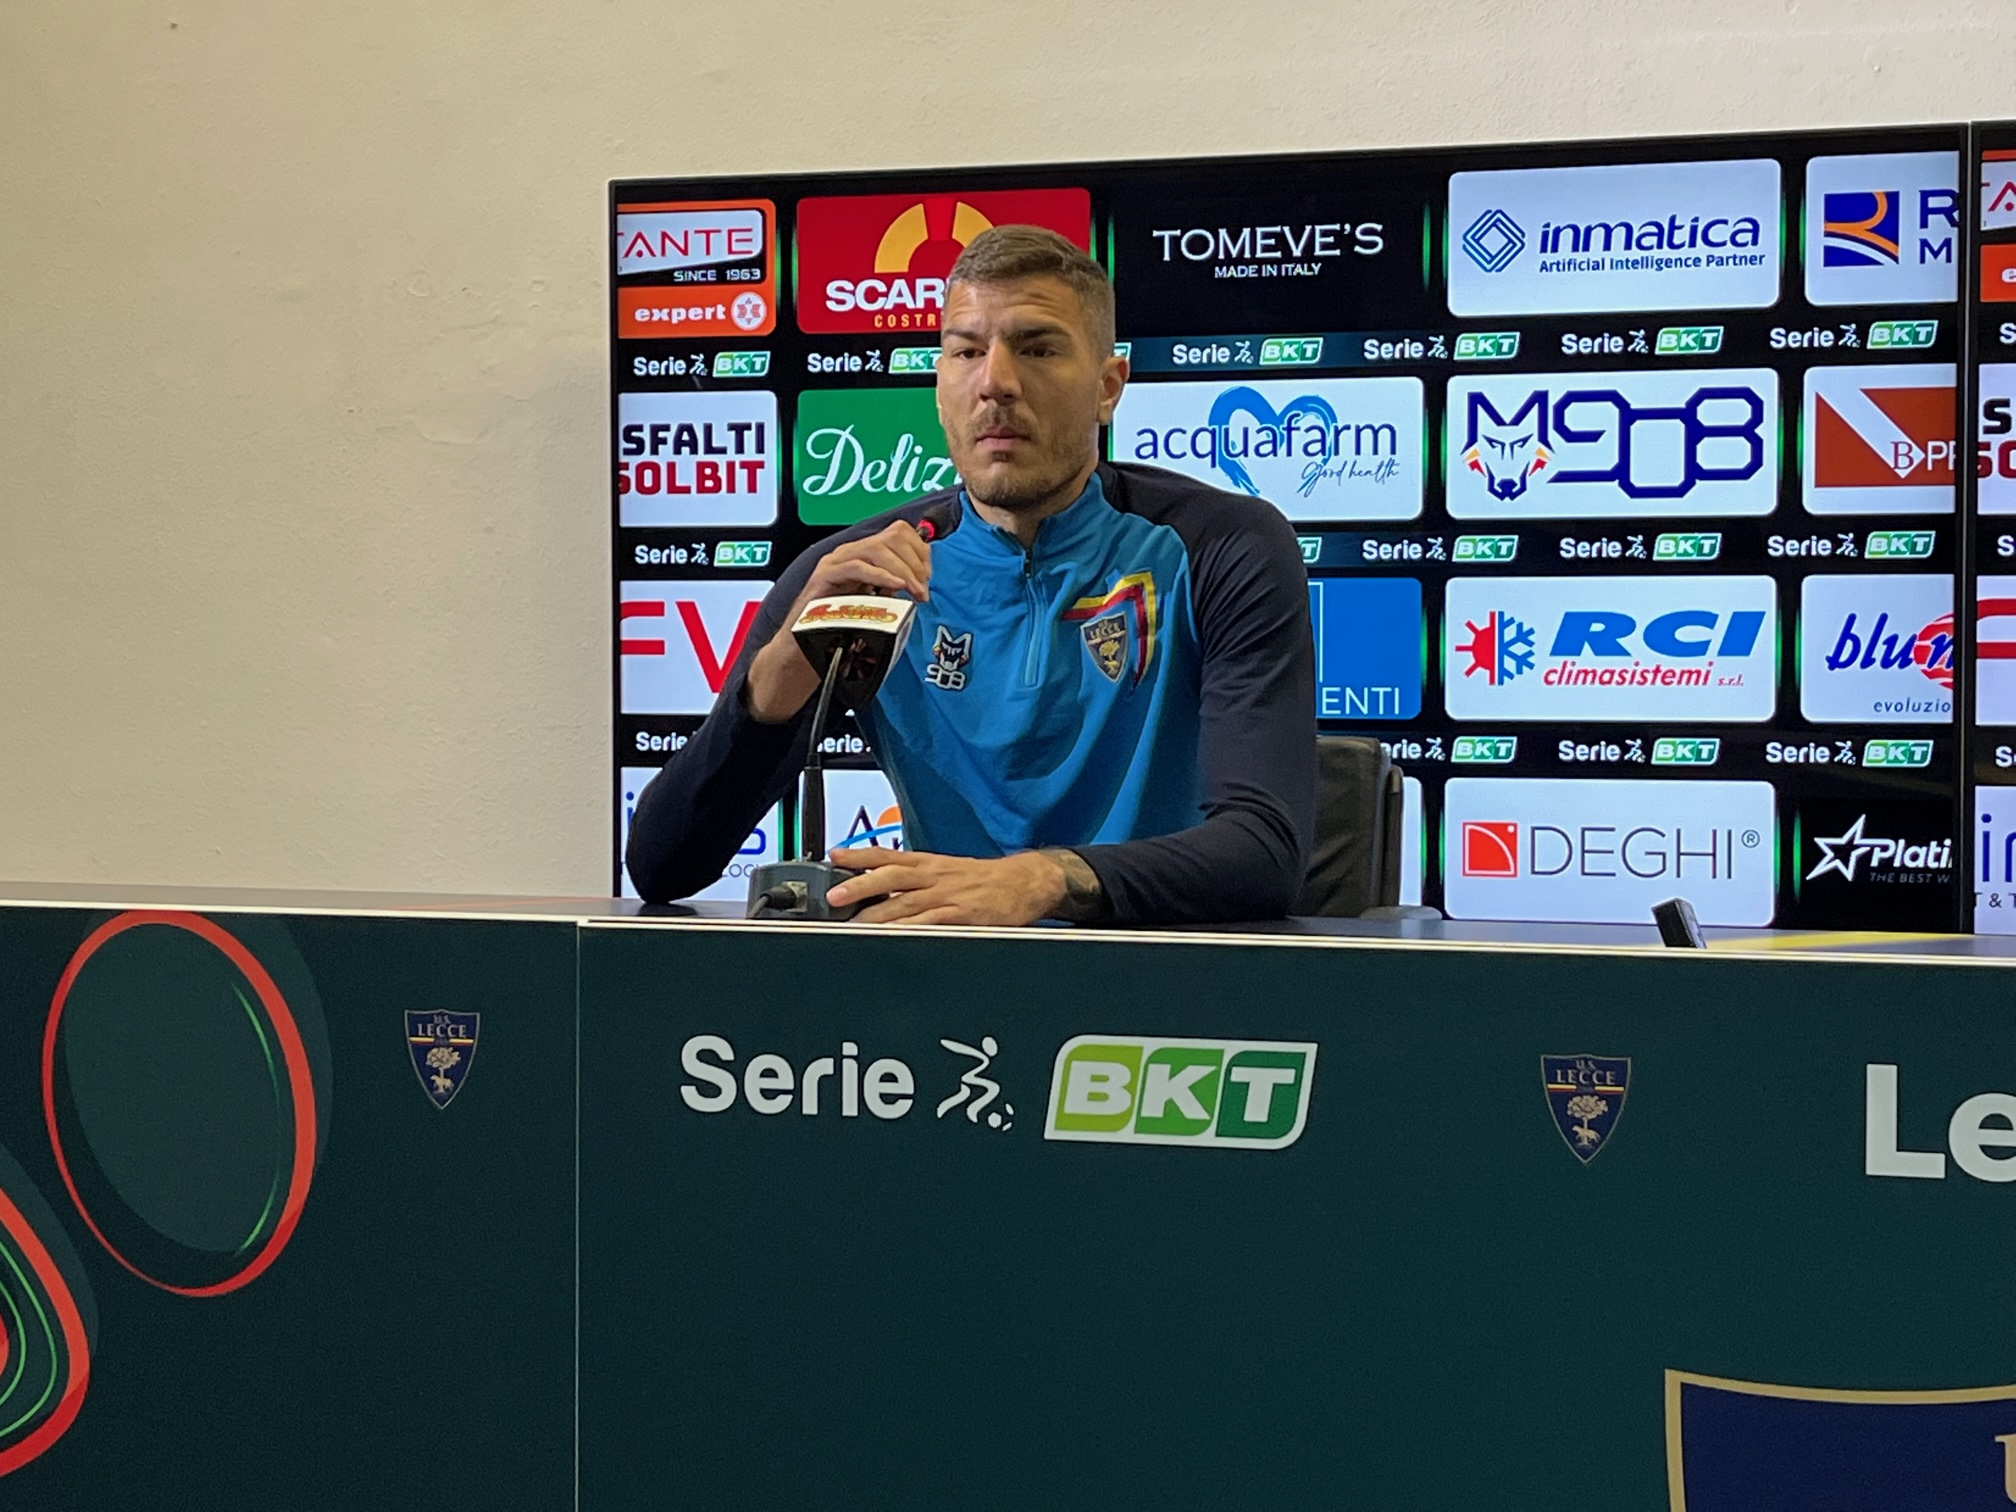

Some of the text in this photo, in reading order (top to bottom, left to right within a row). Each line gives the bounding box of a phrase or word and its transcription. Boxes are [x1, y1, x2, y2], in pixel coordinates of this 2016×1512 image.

[617, 228, 753, 258] ANTE
[1152, 223, 1384, 261] TOMEVE'S
[1539, 213, 1761, 254] inmatica
[1918, 237, 1953, 264] M
[1214, 262, 1322, 278] MADE IN ITALY
[1539, 252, 1766, 273] Artificial Intelligence Partner
[673, 268, 761, 282] SINCE 1963
[825, 278, 948, 312] SCAR
[634, 304, 726, 324] expert
[874, 313, 944, 328] COSTR
[1561, 330, 1719, 355] Serie BKT
[1769, 325, 1933, 348] Serie BKT
[1172, 342, 1319, 364] Serie BKT
[1363, 337, 1517, 360] Serie BKT
[633, 356, 687, 376] Serie
[807, 352, 862, 373] Serie
[622, 422, 765, 455] SFALTI
[1134, 412, 1397, 468] acquafarm
[803, 424, 963, 495] Deliz
[634, 545, 688, 565] Serie
[1362, 539, 1514, 560] Serie BKT
[1559, 537, 1717, 559] Serie BKT
[1767, 535, 1931, 557] Serie BKT
[1549, 610, 1766, 658] RCI
[1543, 660, 1715, 687] climasistemi
[1873, 697, 1951, 713] evoluzio
[635, 731, 688, 751] Serie
[817, 734, 863, 753] erie
[1455, 741, 1513, 758] BKT
[1558, 740, 1716, 762] Serie BKT
[1765, 742, 1929, 763] Serie BKT
[1530, 825, 1732, 880] DEGHI
[1869, 838, 1952, 869] Plati
[1869, 872, 1895, 883] THE
[1899, 873, 1932, 884] BEST
[416, 1023, 468, 1038] LECCE
[680, 1034, 1296, 1123] Serie BKT
[1556, 1069, 1616, 1086] LECCE
